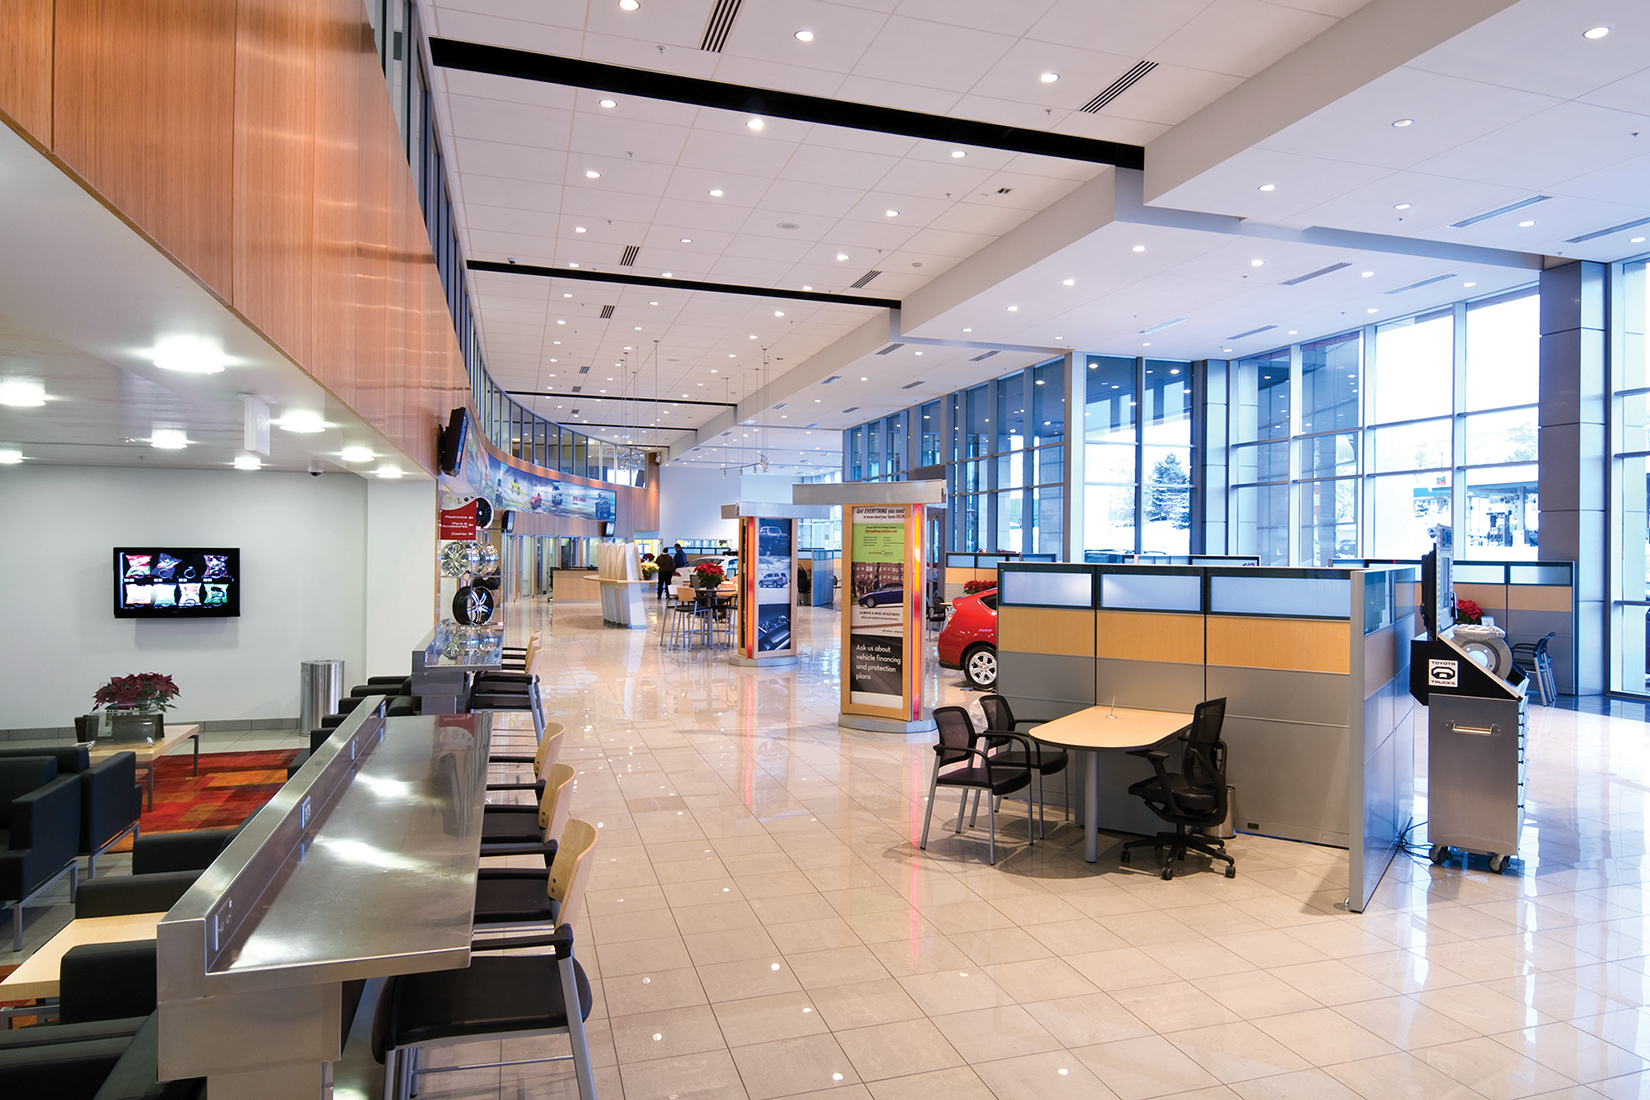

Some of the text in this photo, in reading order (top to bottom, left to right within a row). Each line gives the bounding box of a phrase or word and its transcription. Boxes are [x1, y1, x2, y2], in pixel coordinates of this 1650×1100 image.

[875, 645, 891, 653] about
[856, 653, 901, 665] vehicle financing
[868, 665, 897, 673] protection
[856, 672, 872, 680] plans
